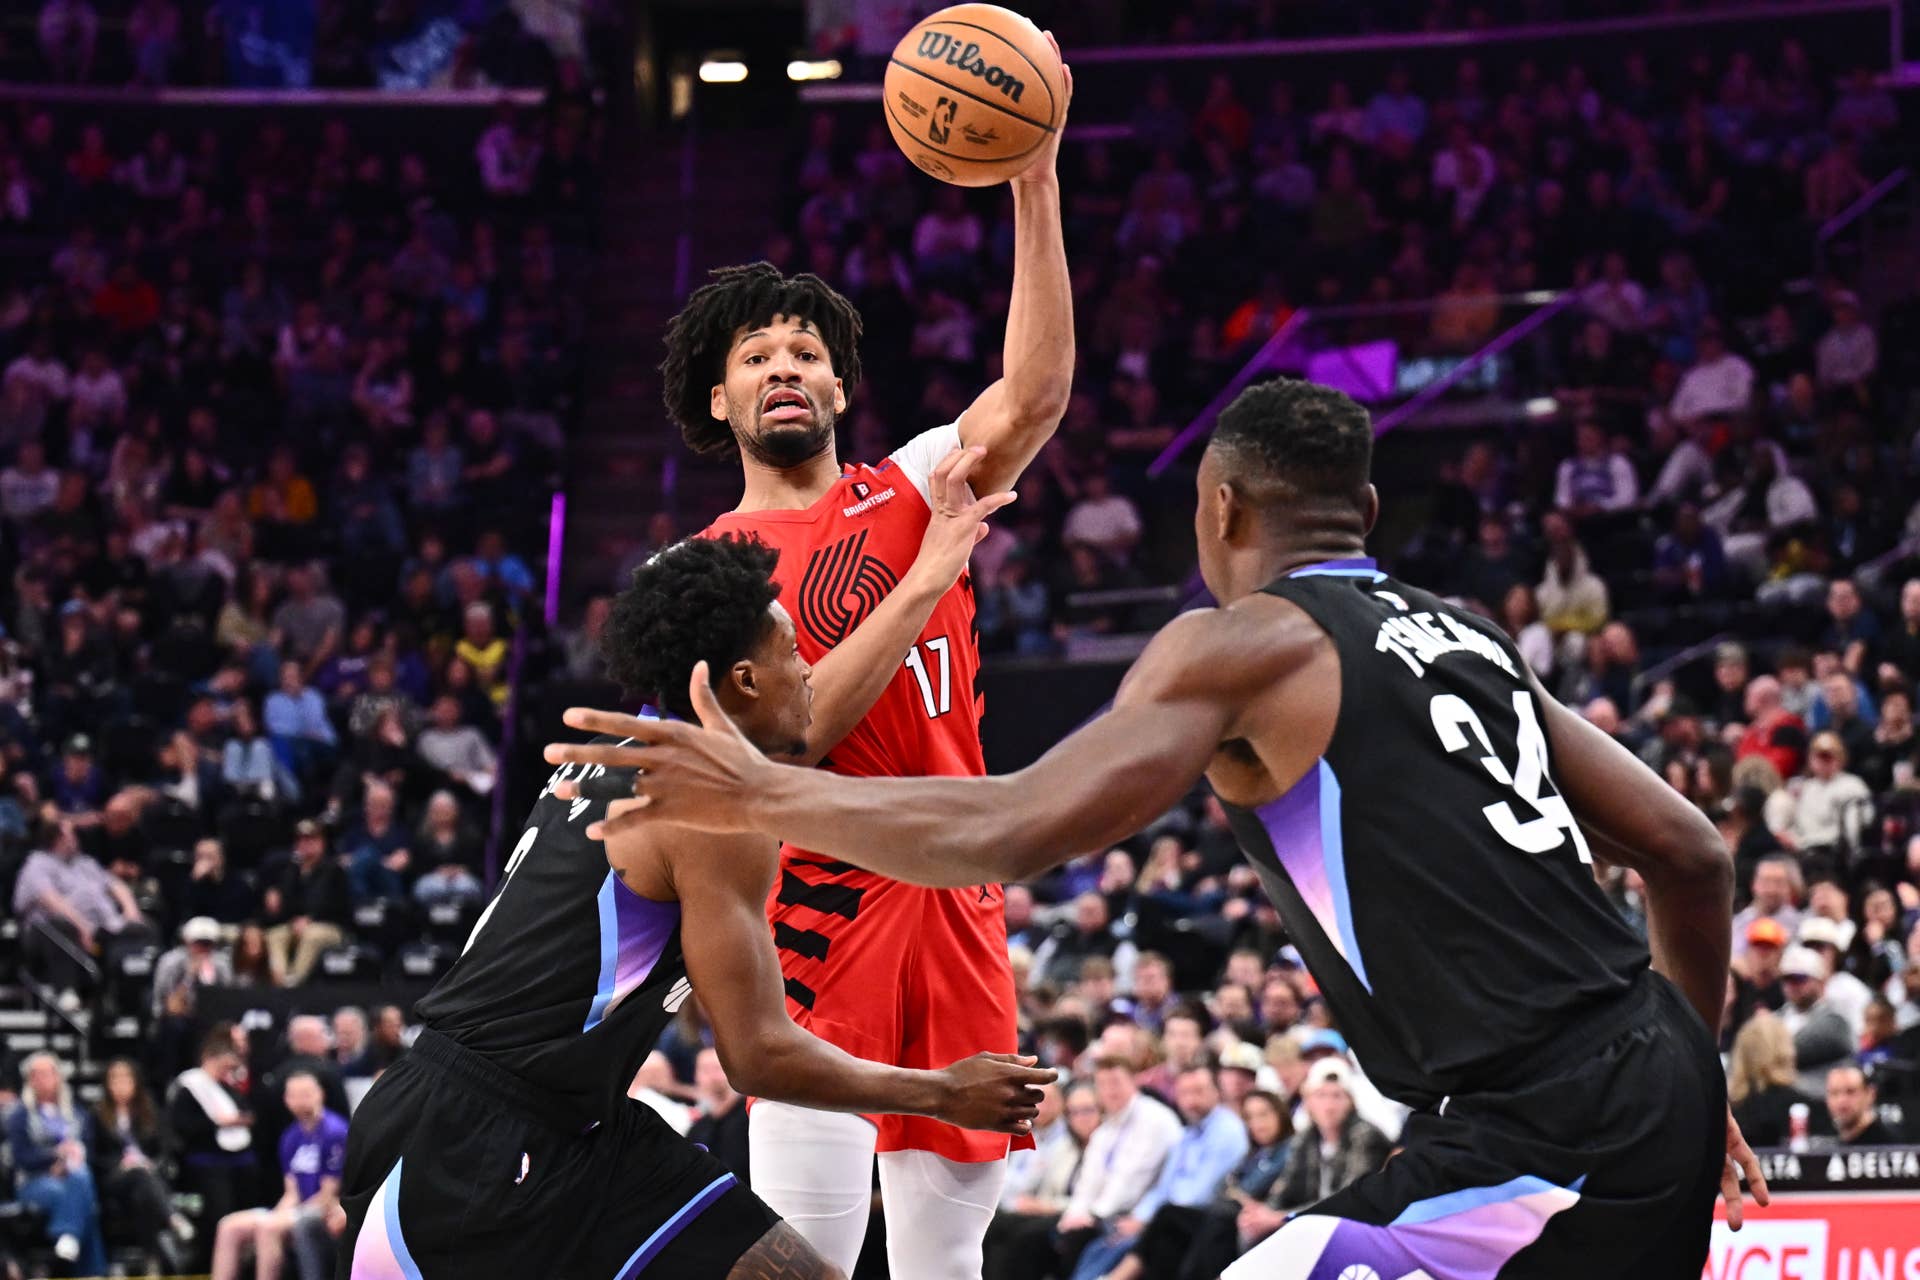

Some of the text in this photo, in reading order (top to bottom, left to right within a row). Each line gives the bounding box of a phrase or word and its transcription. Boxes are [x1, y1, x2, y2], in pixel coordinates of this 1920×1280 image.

[917, 31, 1025, 104] Wilson
[842, 486, 896, 518] BRIGHTSIDE
[856, 482, 870, 498] B
[904, 635, 951, 720] 17
[1430, 690, 1593, 865] 34
[1734, 1154, 1802, 1181] LTA
[1848, 1152, 1920, 1179] DELTA
